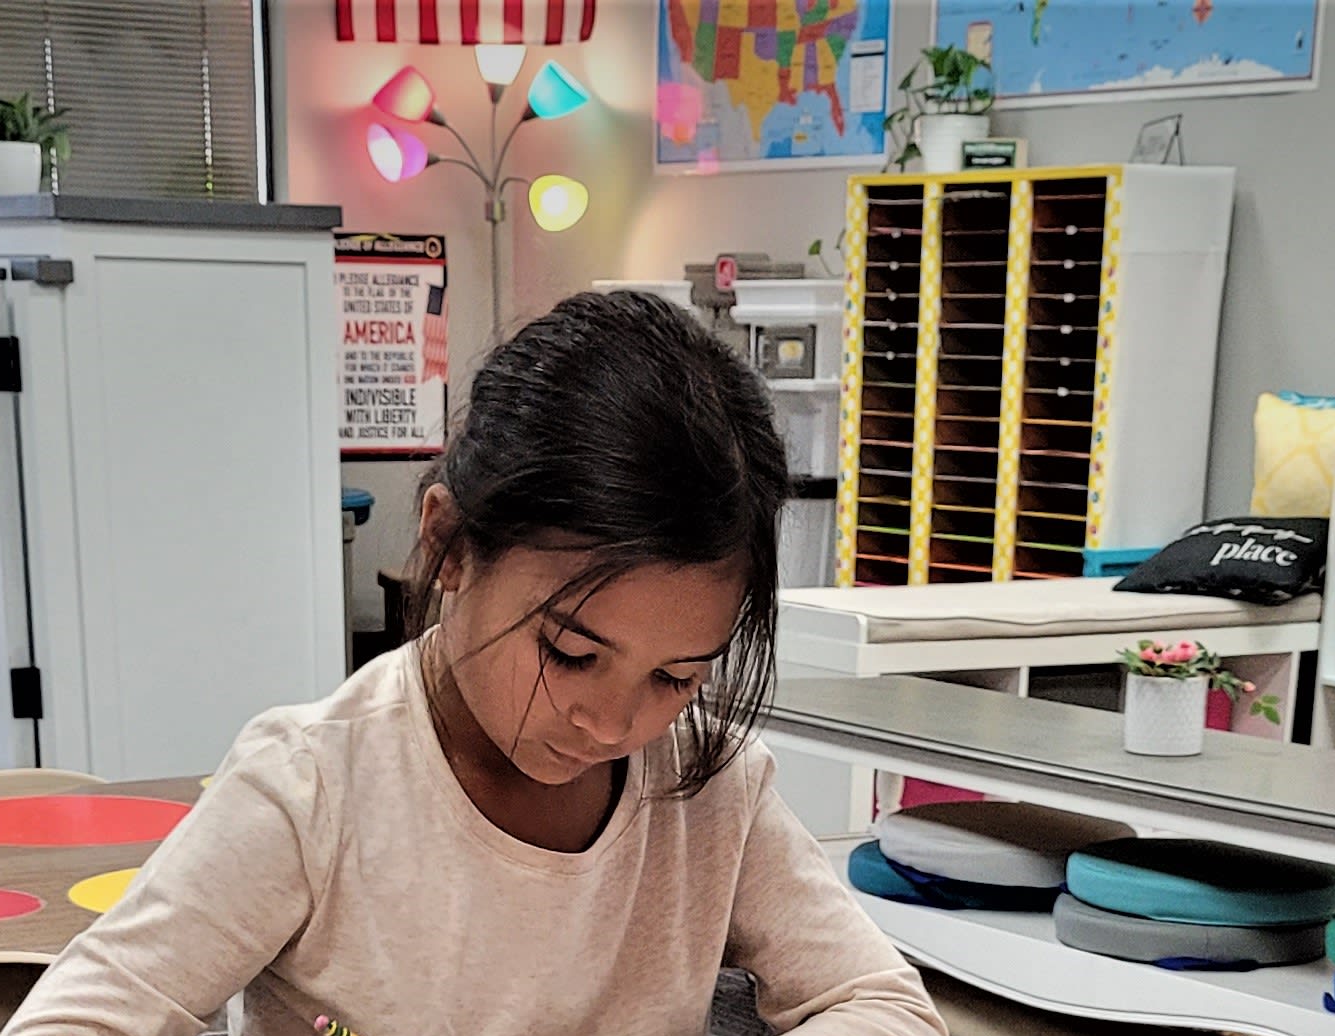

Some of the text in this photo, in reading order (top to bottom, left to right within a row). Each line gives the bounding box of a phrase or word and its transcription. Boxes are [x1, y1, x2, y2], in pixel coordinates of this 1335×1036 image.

[339, 273, 368, 285] PLEDGE
[373, 274, 419, 286] ALLEGIANCE
[354, 287, 364, 297] THE
[368, 287, 384, 298] FLAG
[401, 287, 411, 298] THE
[344, 301, 413, 313] UNITED STATES OF
[344, 320, 416, 344] AMERICA
[345, 388, 416, 406] INDIVISIBLE
[346, 408, 416, 424] WITH LIBERTY
[359, 427, 389, 438] JUSTICE
[391, 427, 407, 438] FOR
[410, 427, 425, 438] ALL
[1210, 539, 1298, 567] place
